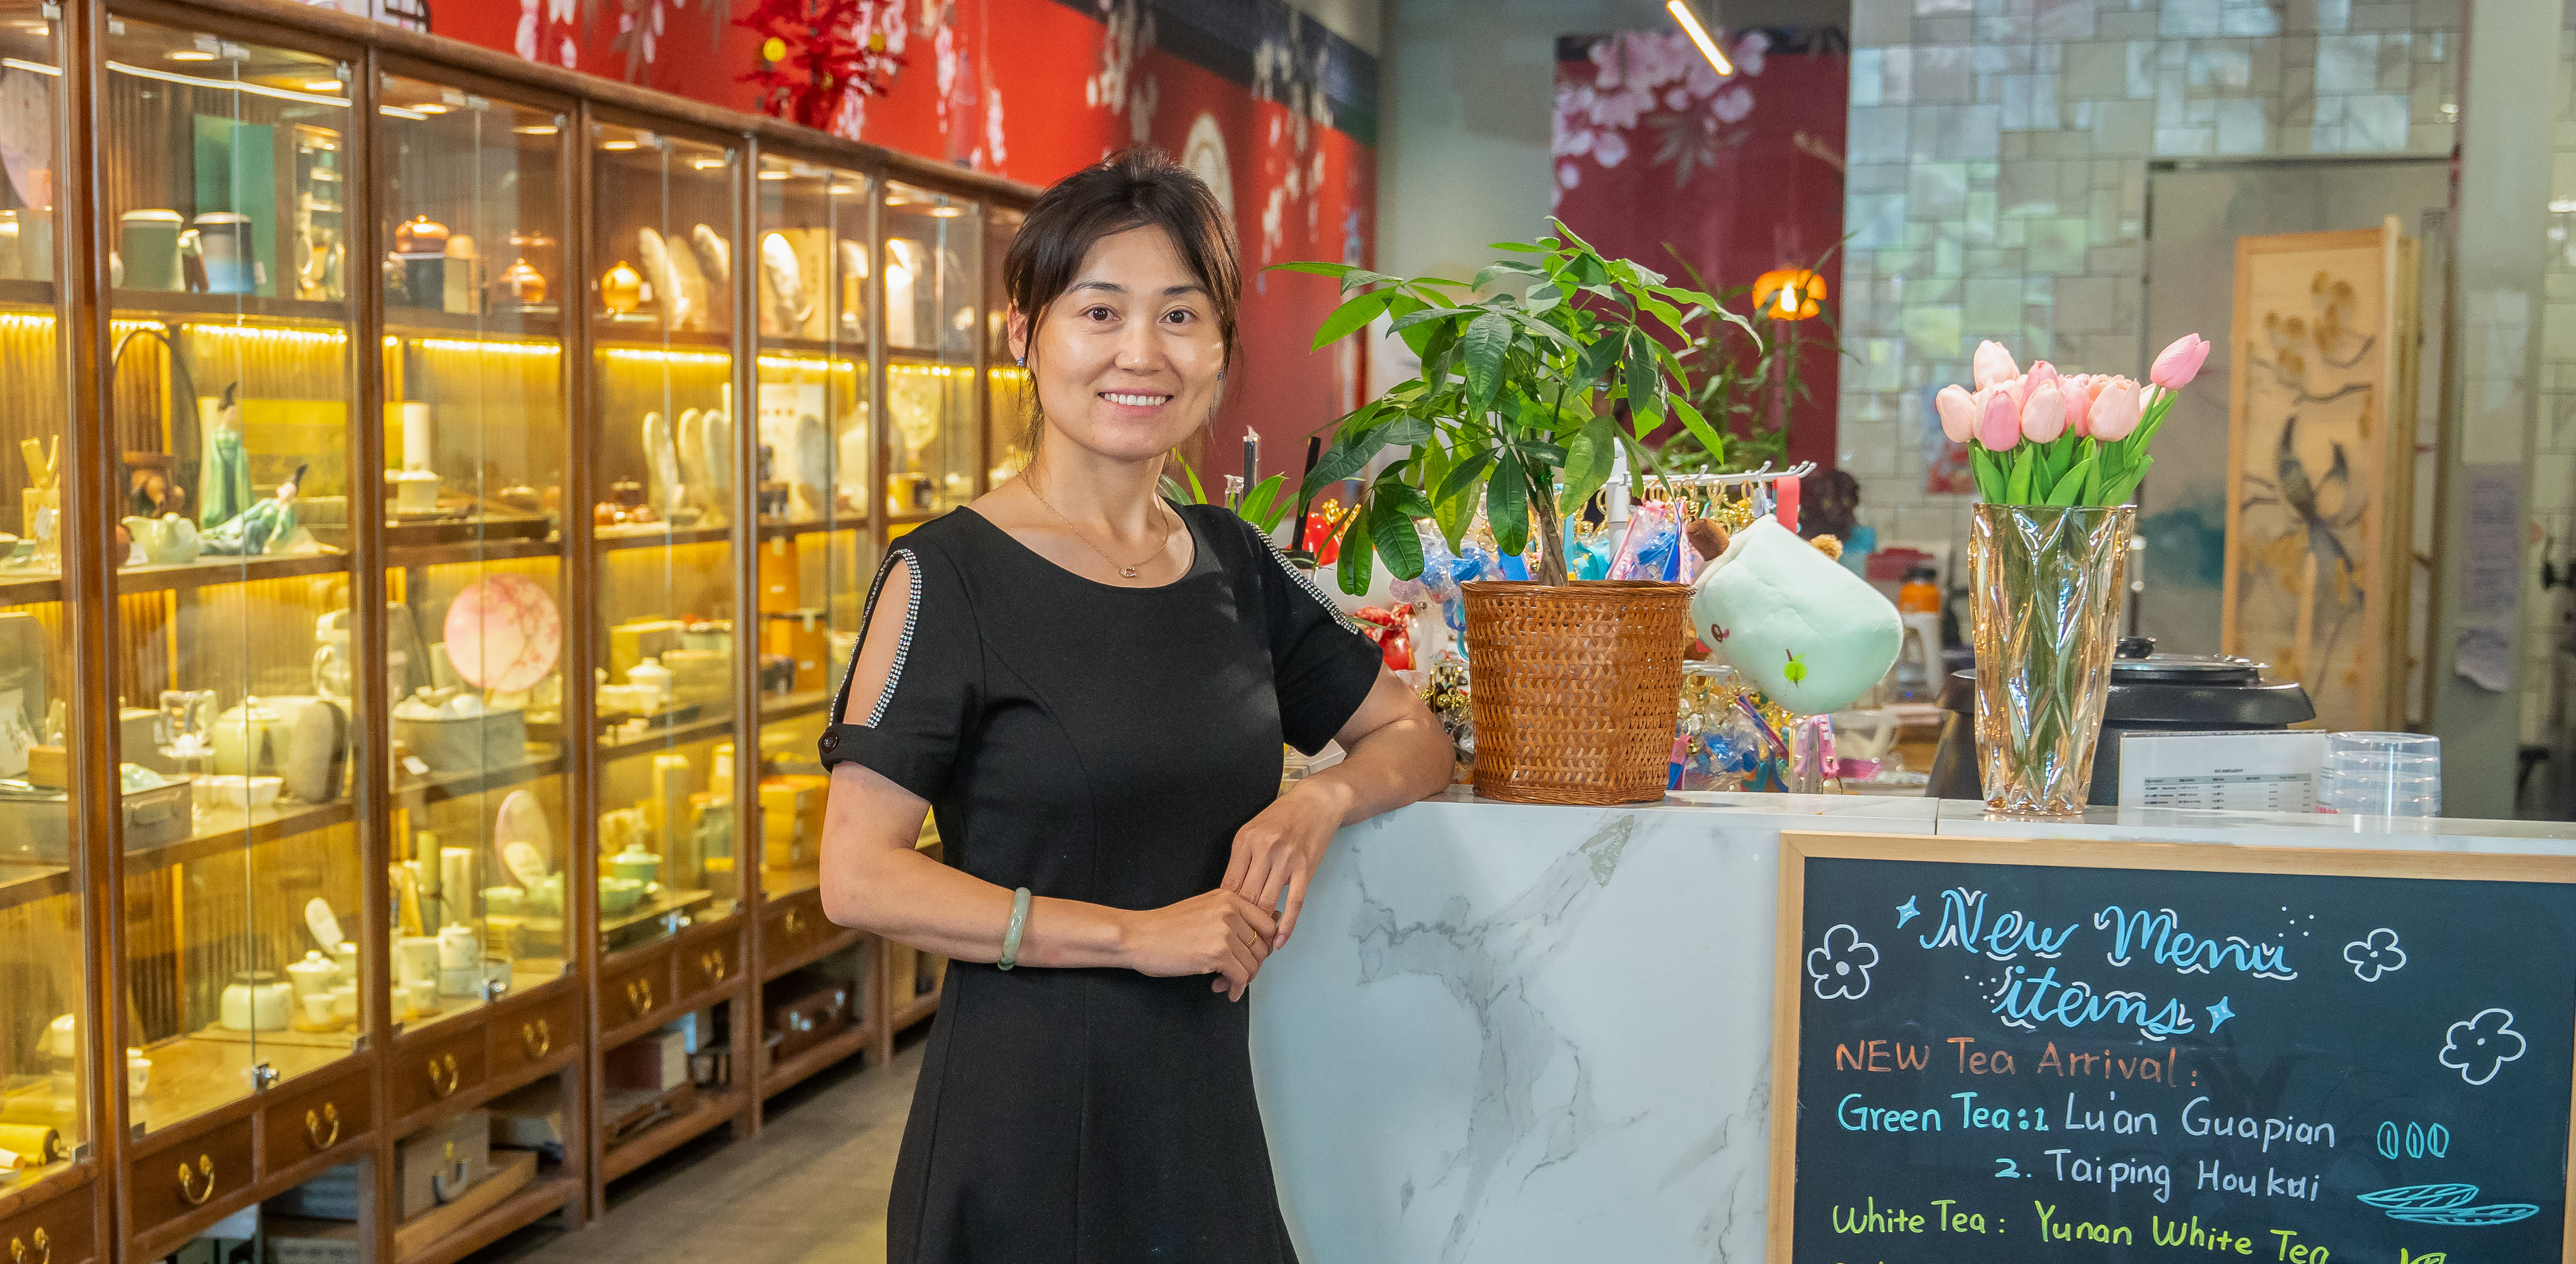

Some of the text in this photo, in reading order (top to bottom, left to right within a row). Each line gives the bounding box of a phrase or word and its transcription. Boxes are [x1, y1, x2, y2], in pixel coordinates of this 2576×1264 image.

[1919, 889, 2292, 972] New Menu
[1992, 965, 2195, 1035] items
[1836, 1040, 1930, 1071] NEW
[1947, 1037, 2015, 1075] Tea
[1837, 1093, 1942, 1132] Green
[2181, 1096, 2335, 1153] Guapian
[1994, 1158, 2032, 1179] 2.
[2044, 1148, 2171, 1203] Taiping
[1832, 1196, 1925, 1234] White
[2034, 1200, 2132, 1246] Yunan
[2152, 1215, 2253, 1255] White
[2270, 1229, 2329, 1264] Tea
